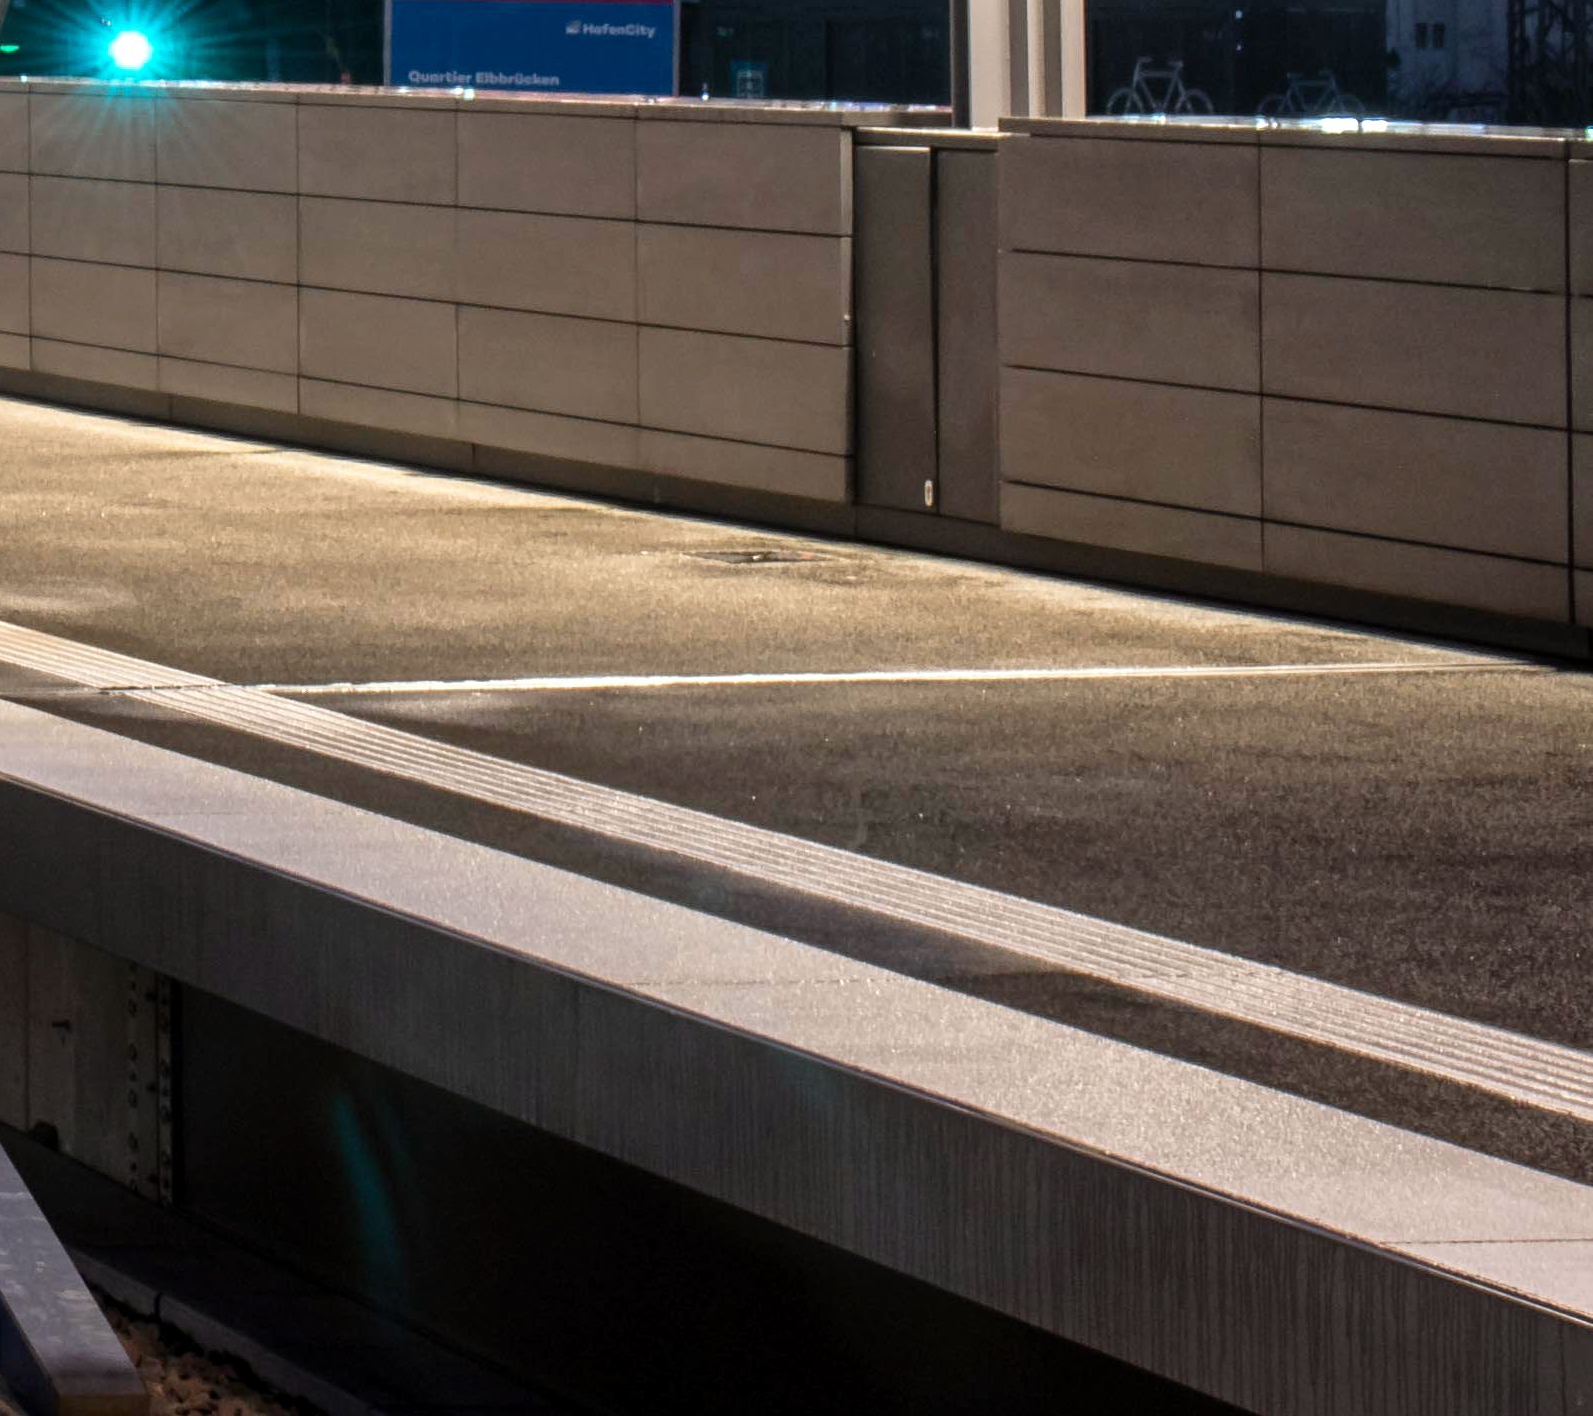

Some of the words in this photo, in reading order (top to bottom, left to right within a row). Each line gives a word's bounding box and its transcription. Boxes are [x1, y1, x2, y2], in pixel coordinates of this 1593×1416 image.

[582, 22, 656, 39] HafenCity
[408, 69, 472, 84] Quartier
[475, 70, 560, 87] Elbbrücken
